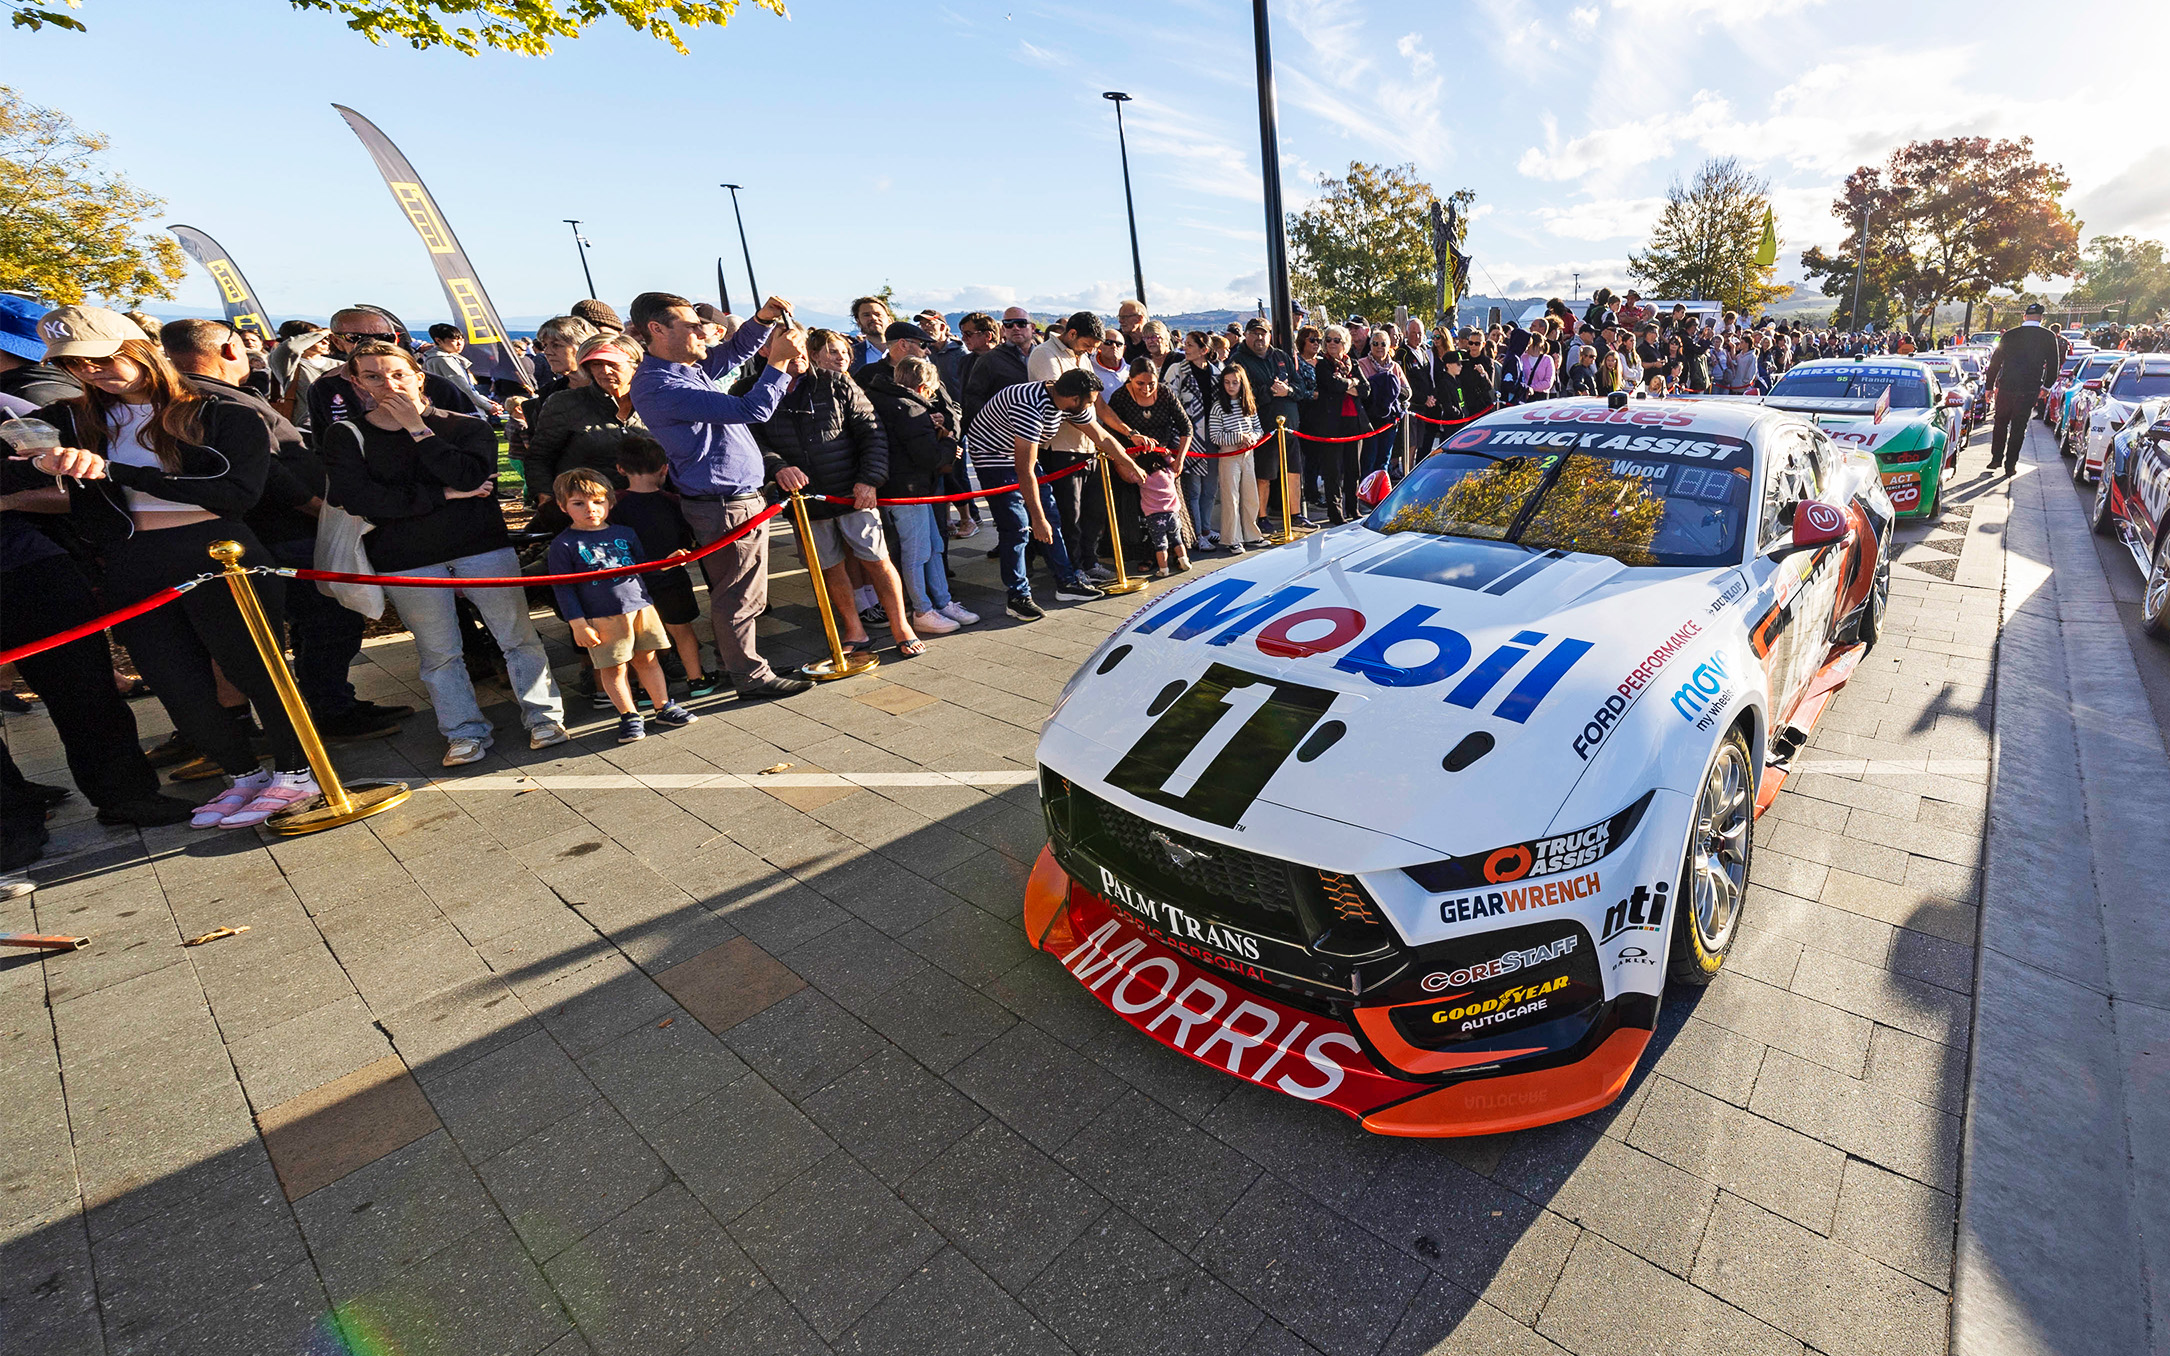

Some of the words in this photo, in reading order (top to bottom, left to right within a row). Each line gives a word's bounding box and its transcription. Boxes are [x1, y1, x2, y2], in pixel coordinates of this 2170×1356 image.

[1788, 367, 1864, 377] HERZOG
[1868, 367, 1921, 378] STEEL
[1861, 376, 1895, 384] Randle
[1522, 406, 1697, 428] coates
[1770, 400, 1870, 409] ASSIST
[1488, 430, 1603, 448] TRUCK
[1597, 434, 1743, 461] ASSIST
[1823, 428, 1878, 446] trol
[1539, 455, 1559, 469] 2
[1611, 459, 1670, 479] Wood
[1890, 473, 1913, 484] ACT
[1711, 581, 1743, 612] DUNLOP
[1131, 577, 1595, 725] Mobil
[1670, 649, 1730, 723] move
[1696, 713, 1715, 732] my
[1159, 682, 1278, 799] 1
[1535, 819, 1612, 856] TRUCK
[1528, 838, 1610, 877] ASSIST
[1099, 865, 1160, 923] PALM
[1162, 901, 1260, 960] TRANS
[1440, 871, 1601, 924] GEARWRENCH
[1600, 881, 1669, 941] nti
[1167, 936, 1274, 985] PERSONAL
[1612, 957, 1656, 971] OAKLEY
[1061, 918, 1362, 1100] MORRIS
[1432, 975, 1571, 1025] GOODYEAR
[1461, 998, 1549, 1032] AUTOCARE
